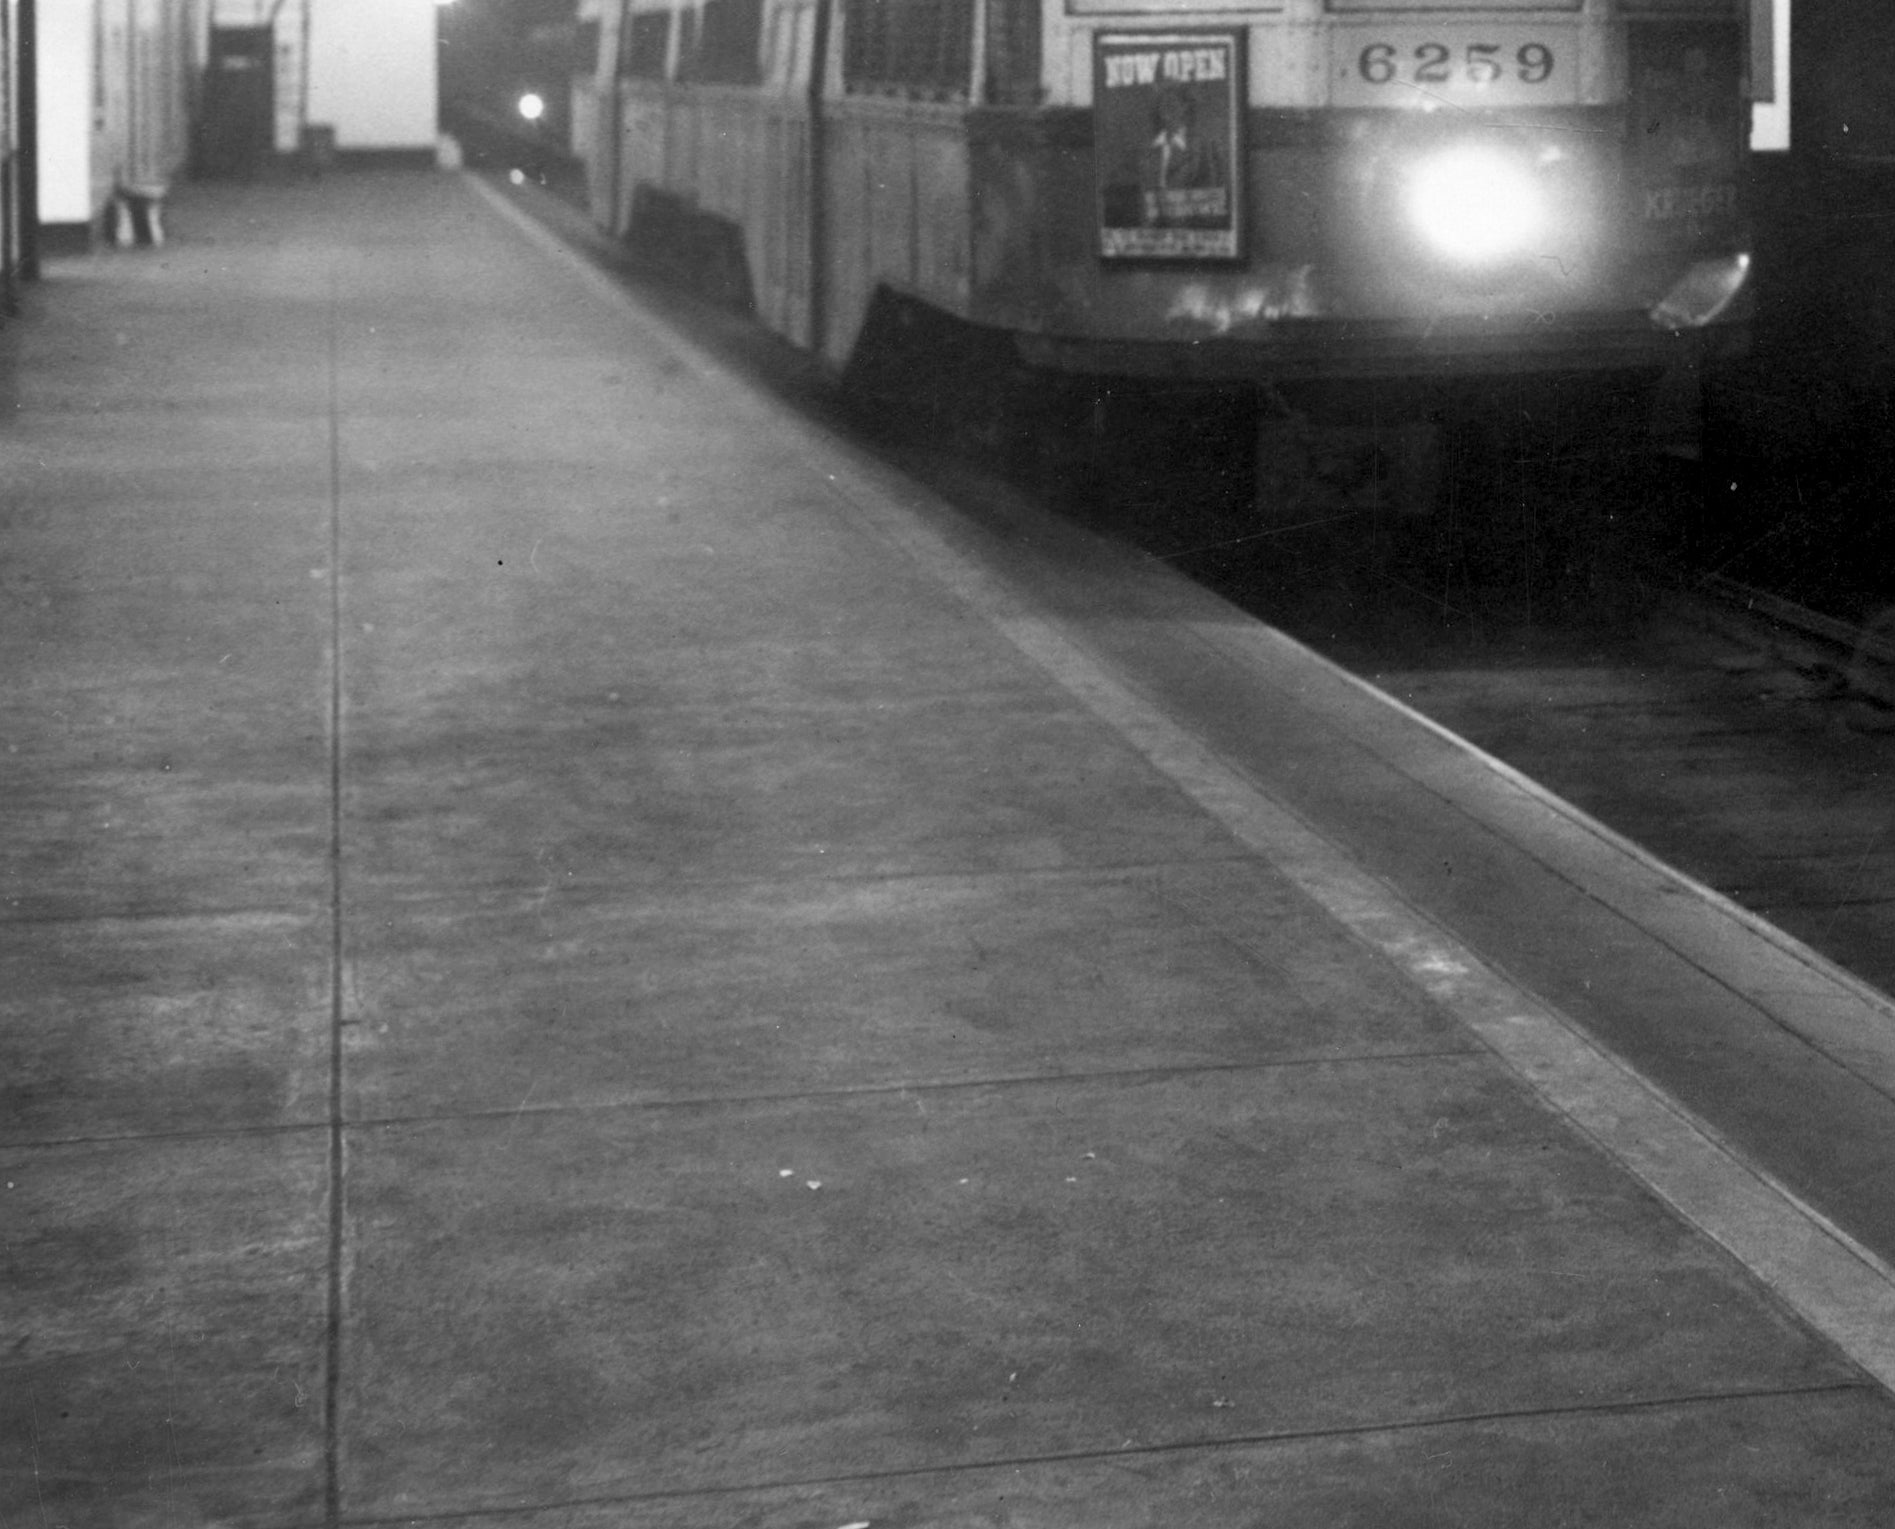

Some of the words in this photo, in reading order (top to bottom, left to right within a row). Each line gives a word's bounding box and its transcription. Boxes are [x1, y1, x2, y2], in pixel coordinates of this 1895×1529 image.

[1104, 53, 1160, 89] NOW
[1163, 49, 1227, 82] OPEN
[1358, 43, 1557, 86] 6259
